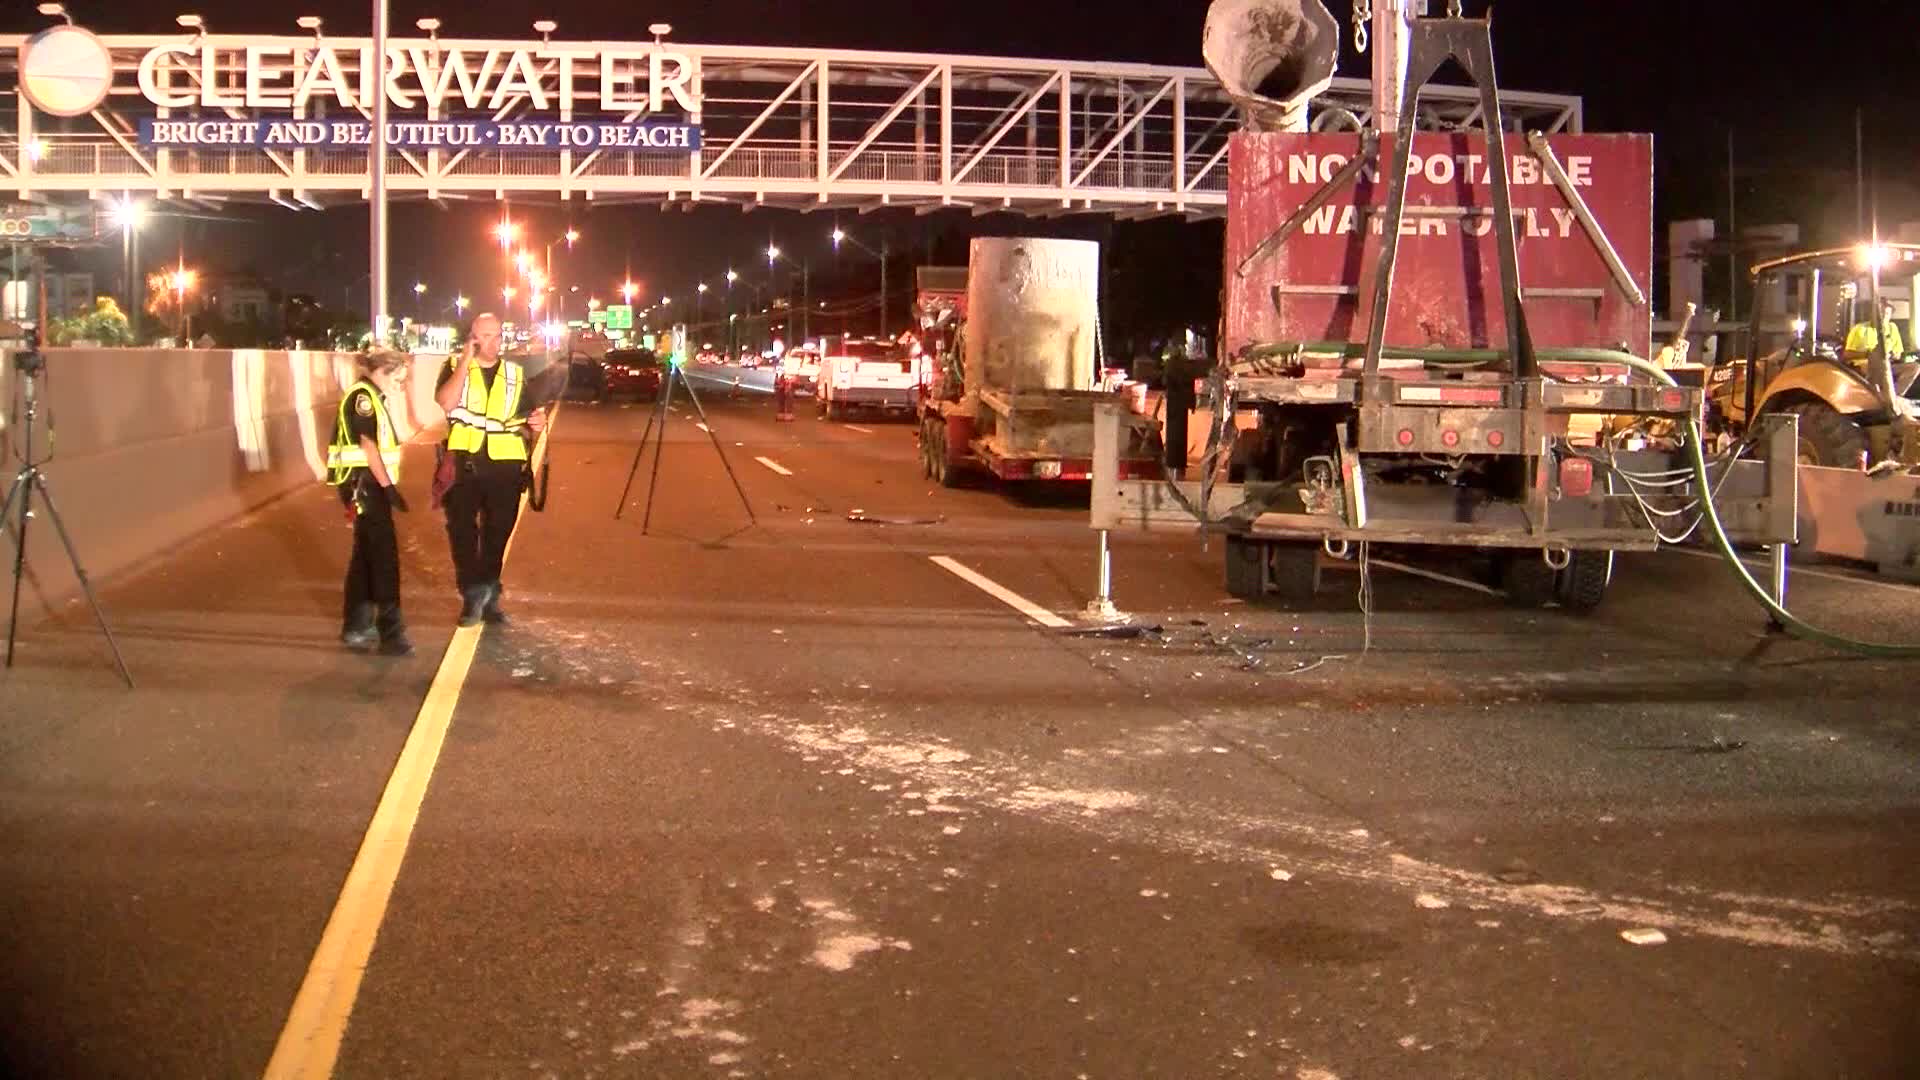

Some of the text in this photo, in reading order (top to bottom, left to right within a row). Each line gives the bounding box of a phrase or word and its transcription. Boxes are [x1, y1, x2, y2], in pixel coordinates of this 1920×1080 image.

[137, 44, 700, 112] CLEARWATER
[151, 122, 258, 143] BRIGHT
[264, 122, 326, 144] AND
[497, 124, 551, 145] BAY
[553, 125, 594, 147] TO
[598, 126, 689, 147] BEACH
[1462, 207, 1578, 238] OLY
